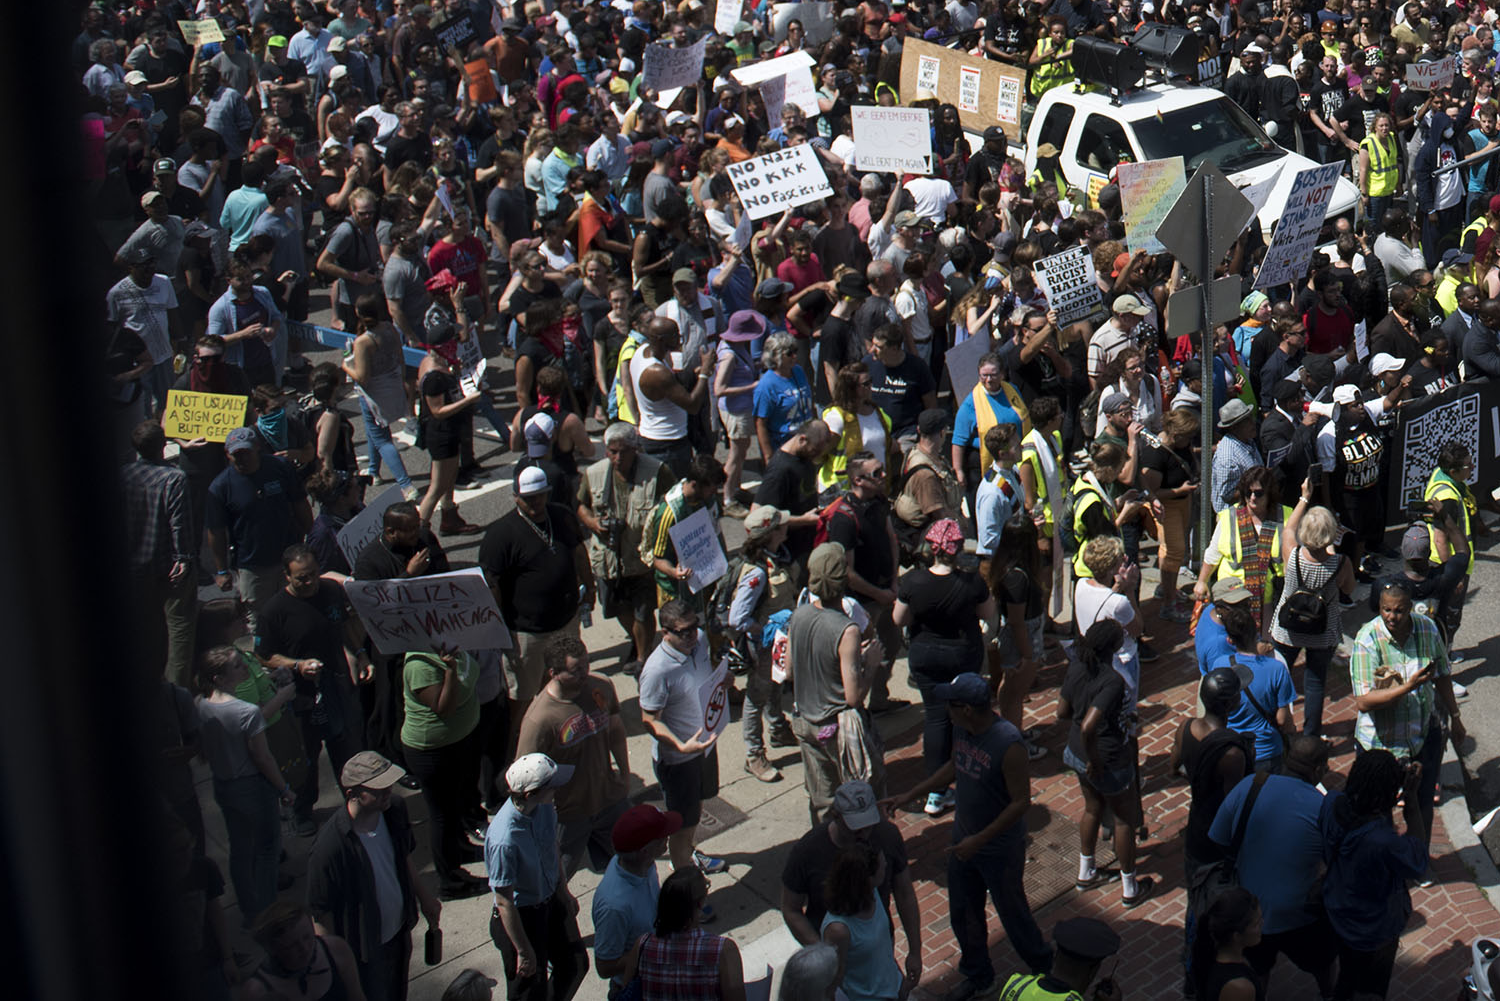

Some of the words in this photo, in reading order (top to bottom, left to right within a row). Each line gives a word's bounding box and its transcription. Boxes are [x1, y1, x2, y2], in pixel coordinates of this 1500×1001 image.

[1197, 56, 1221, 80] NO!
[1415, 63, 1438, 76] WE
[730, 161, 756, 179] NO
[762, 147, 801, 167] Nazi
[736, 177, 760, 192] NO
[1291, 164, 1342, 195] BOSTON
[743, 195, 770, 210] NO
[1287, 196, 1304, 210] WILL
[1304, 185, 1333, 208] NOT
[1278, 206, 1310, 231] STAND
[1310, 202, 1328, 219] FOR
[1273, 226, 1295, 247] White
[1043, 248, 1084, 269] UNITE
[1045, 258, 1086, 276] AGAINST
[1046, 264, 1088, 285] RACIST
[1051, 275, 1088, 295] HATE
[1051, 296, 1060, 307] &
[1060, 283, 1098, 302] SEXIST
[174, 394, 201, 408] NOT
[203, 396, 248, 412] USUALLY
[169, 410, 179, 420] A
[183, 409, 210, 422] SIGN
[212, 412, 240, 426] GUY
[178, 423, 202, 435] BUT
[362, 582, 468, 607] SIKILIZA
[417, 606, 504, 638] WAHENGA
